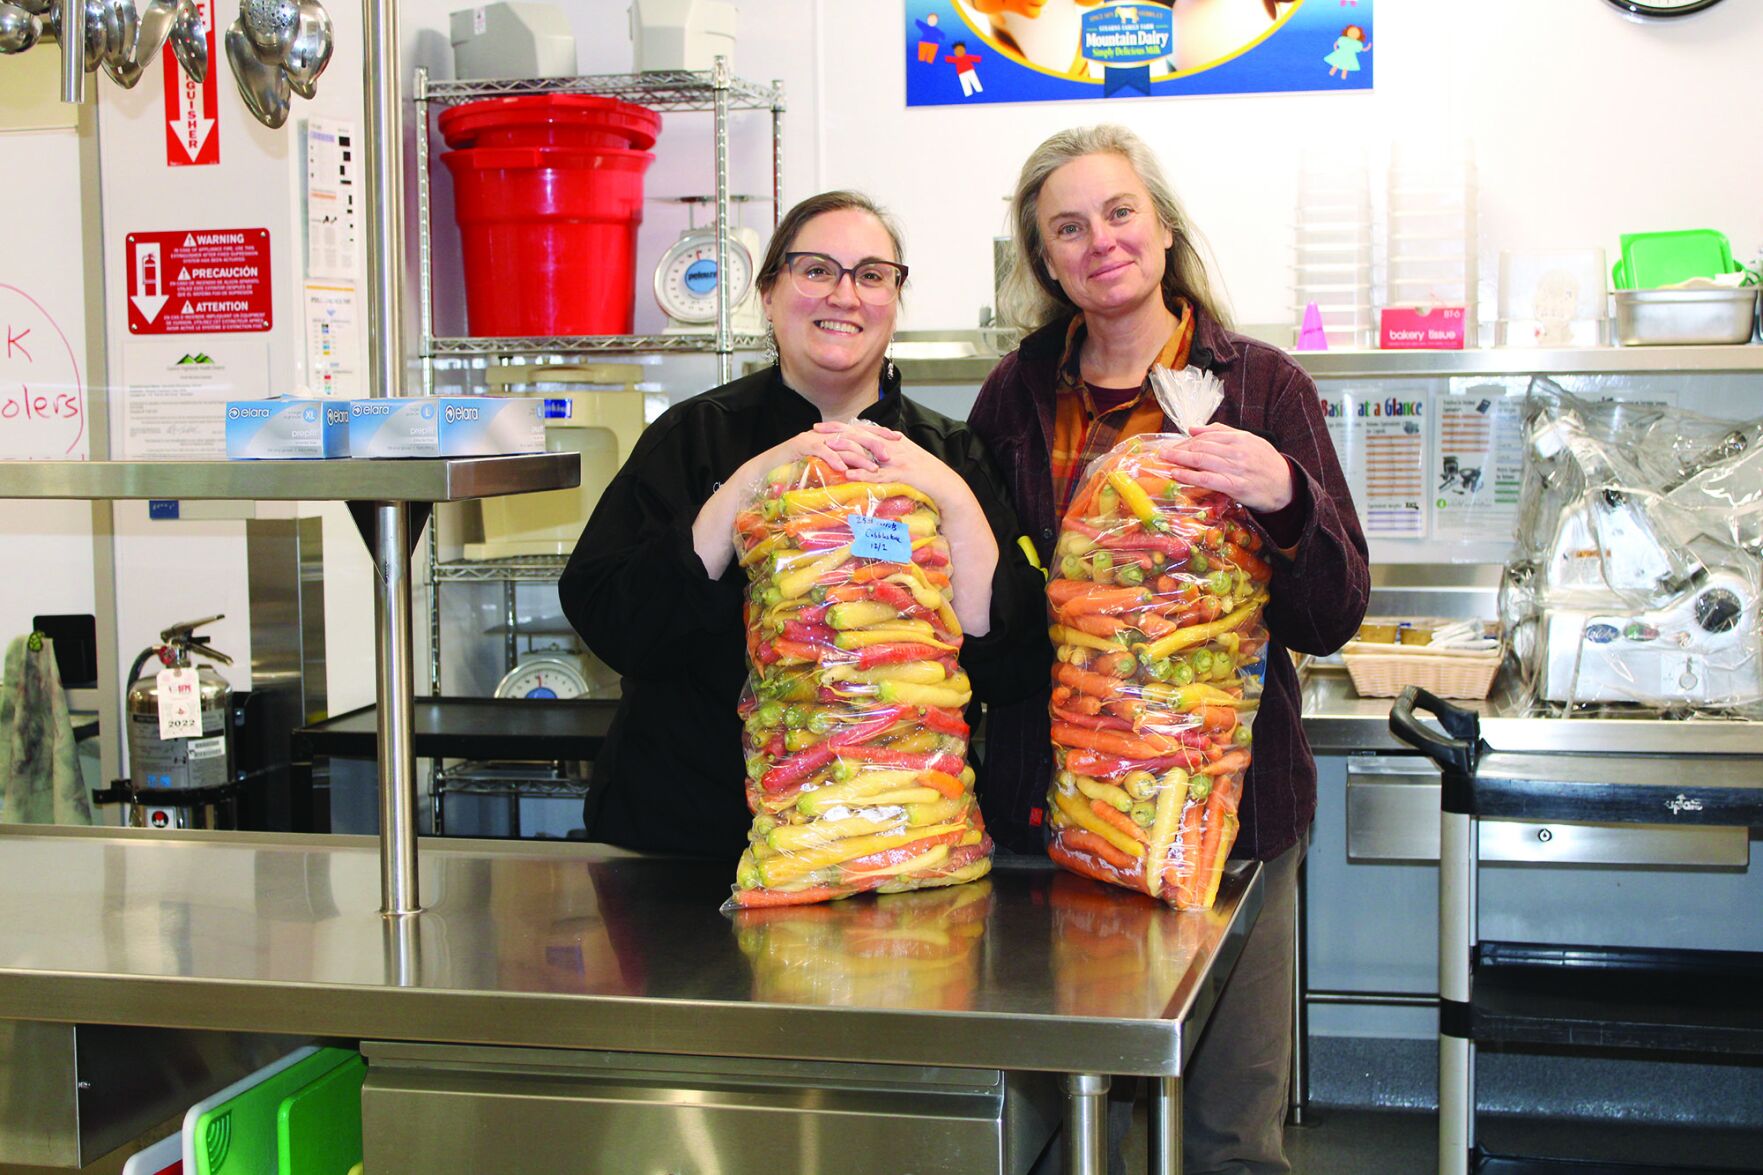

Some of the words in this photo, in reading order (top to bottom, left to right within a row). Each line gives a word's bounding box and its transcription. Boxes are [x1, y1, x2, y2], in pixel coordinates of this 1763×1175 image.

[1086, 31, 1137, 47] Mountain
[1138, 30, 1169, 48] Dairy
[196, 233, 245, 246] WARNING
[191, 265, 259, 279] PRECAUCIÓN
[195, 301, 249, 312] ATTENTION
[1388, 329, 1425, 342] bakery
[1427, 328, 1457, 340] tissue
[7, 325, 33, 363] K
[240, 408, 270, 417] elara
[363, 405, 390, 415] elara
[424, 408, 432, 417] L
[455, 405, 479, 420] elara
[1358, 399, 1371, 417] at
[1374, 402, 1382, 416] a
[1385, 396, 1423, 417] Glance
[304, 409, 315, 419] XL
[168, 720, 195, 728] 2022
